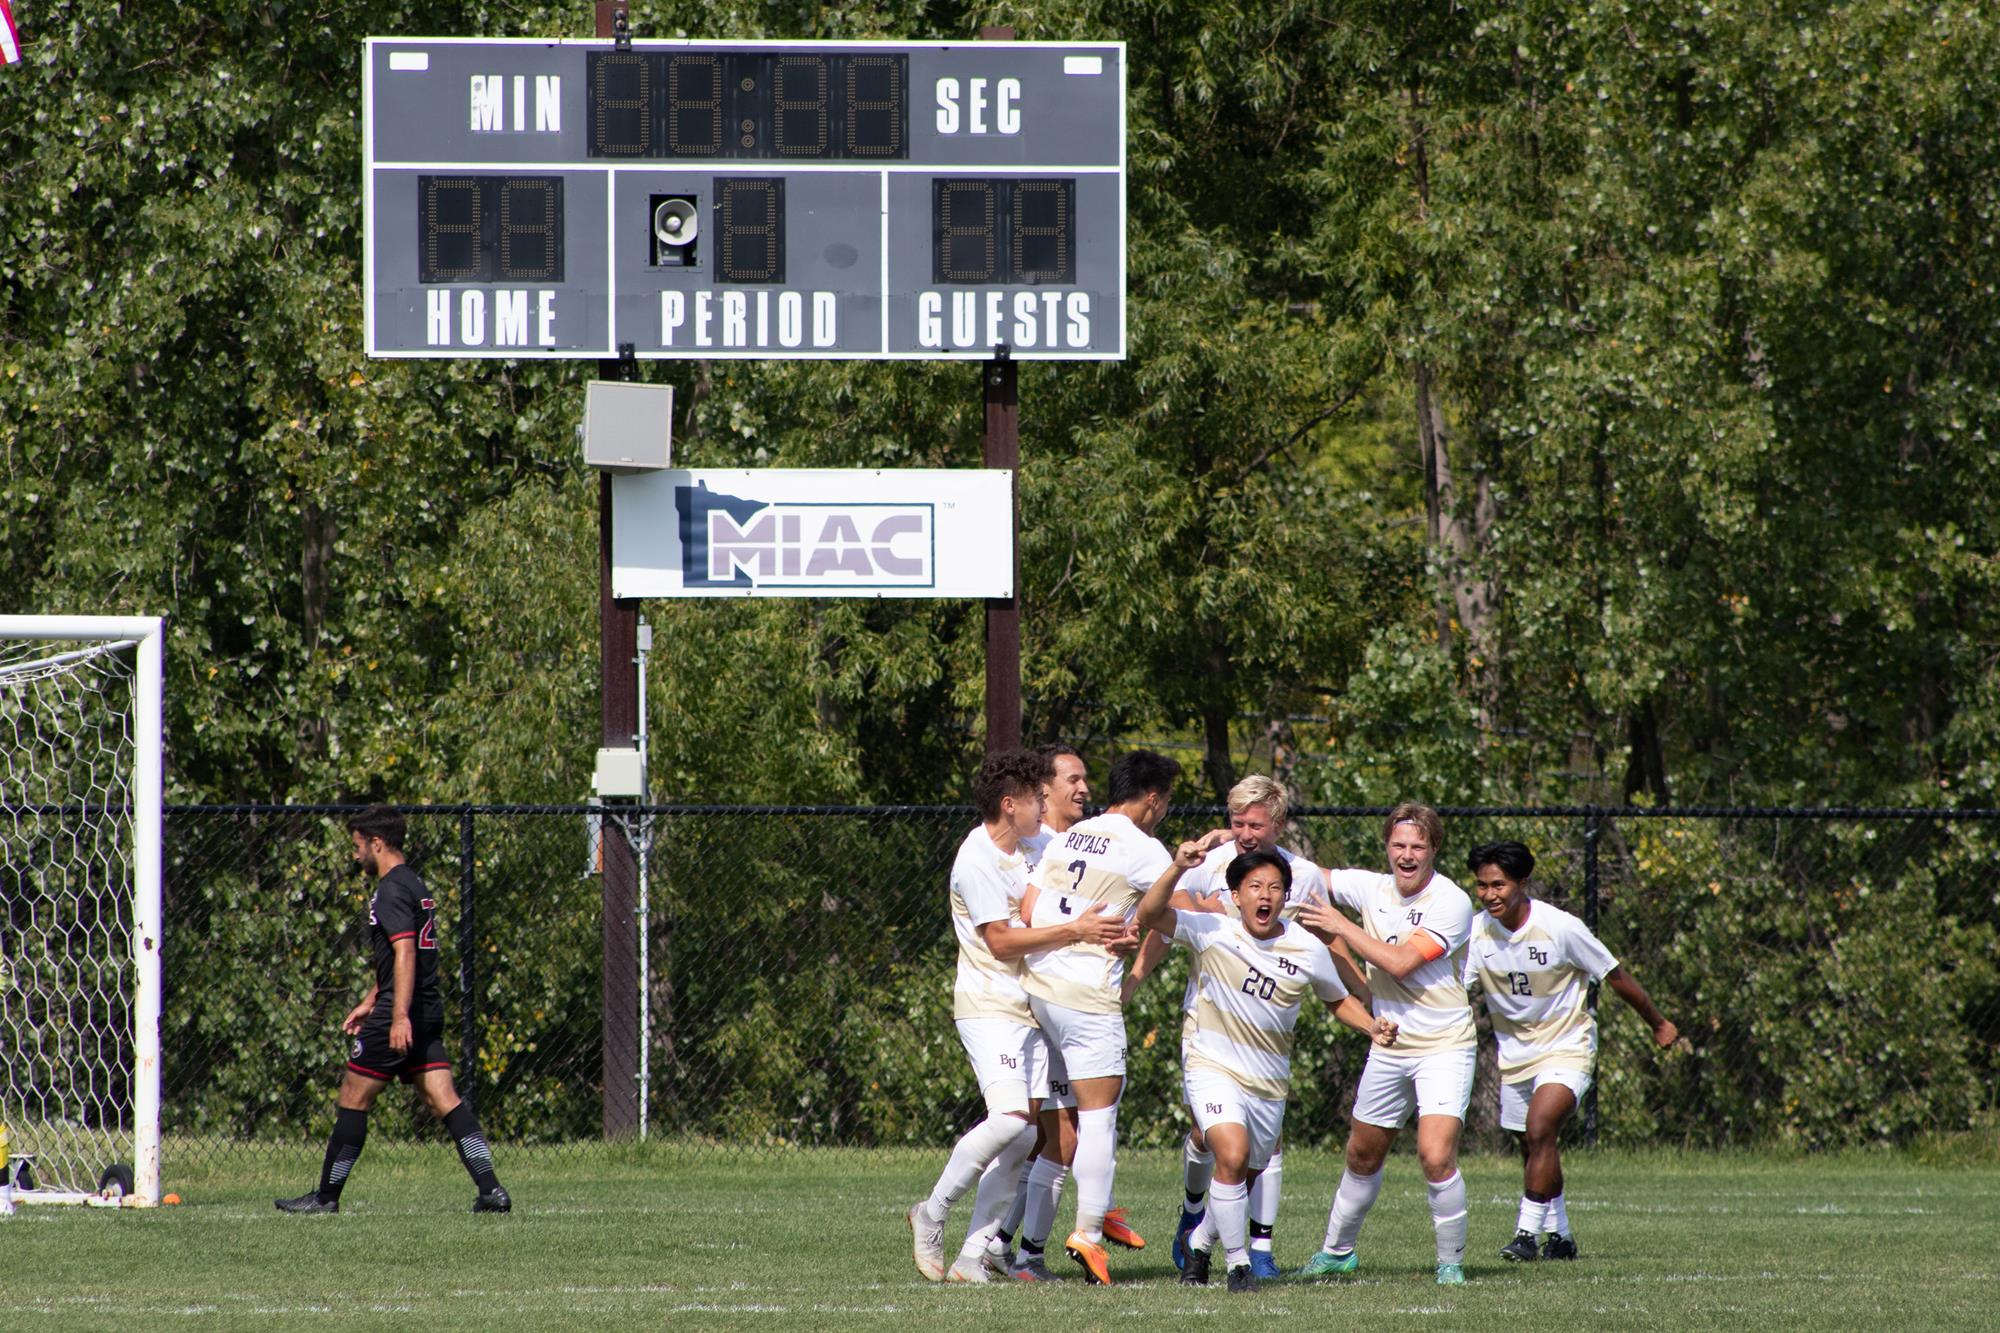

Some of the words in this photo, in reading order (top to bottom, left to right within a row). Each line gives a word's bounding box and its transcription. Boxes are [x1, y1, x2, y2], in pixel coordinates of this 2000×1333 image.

[470, 75, 561, 132] MIN
[936, 78, 1021, 134] SEC
[427, 289, 556, 347] HOME
[661, 290, 836, 348] PERIOD
[918, 291, 1090, 348] GUESTS
[712, 514, 923, 577] MIAC
[1065, 832, 1110, 855] ROYALS
[1278, 956, 1299, 976] BU
[1528, 946, 1548, 966] BU
[1241, 966, 1277, 1001] 20
[1508, 972, 1533, 996] 12
[1000, 1054, 1017, 1069] BU
[1050, 1080, 1069, 1097] BU
[1205, 1102, 1223, 1115] BU
